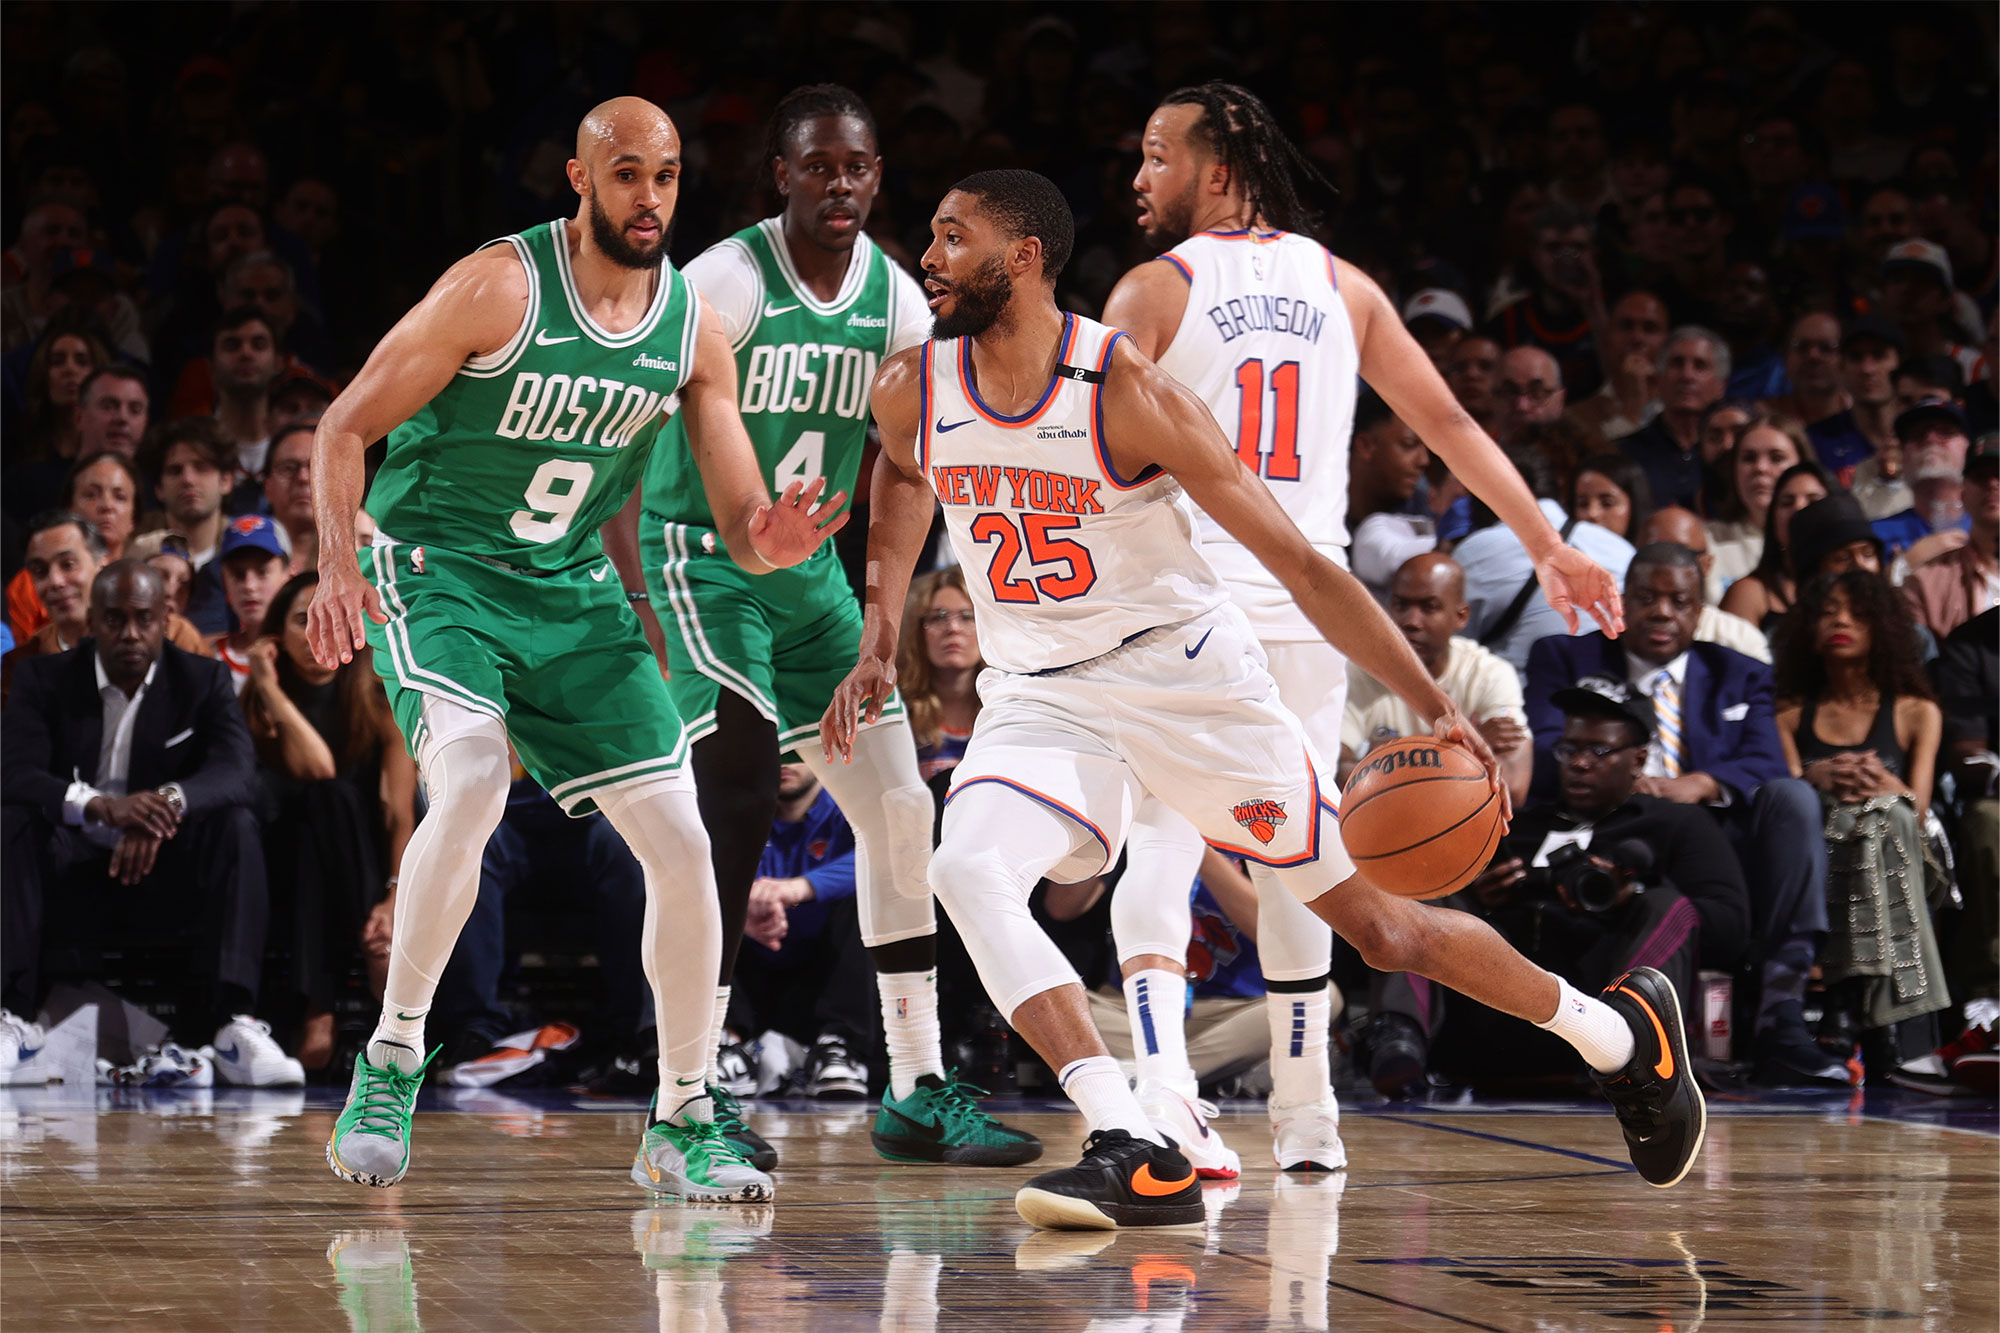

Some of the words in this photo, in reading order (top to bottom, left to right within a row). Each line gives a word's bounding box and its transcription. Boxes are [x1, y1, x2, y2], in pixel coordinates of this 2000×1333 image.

[847, 313, 887, 328] Amica
[1207, 295, 1326, 345] BRUNSON
[632, 352, 677, 372] Amica
[1073, 369, 1085, 380] 12
[495, 372, 669, 448] BOSTON
[1037, 431, 1056, 439] abu
[1058, 429, 1087, 439] dhabi
[1235, 357, 1301, 482] 11
[775, 430, 827, 515] 4
[932, 466, 1001, 506] NEW
[1004, 467, 1105, 515] YORK
[509, 458, 594, 544] 9
[970, 512, 1098, 605] 25
[1346, 748, 1443, 794] Wilson
[1234, 800, 1288, 822] KNICKS
